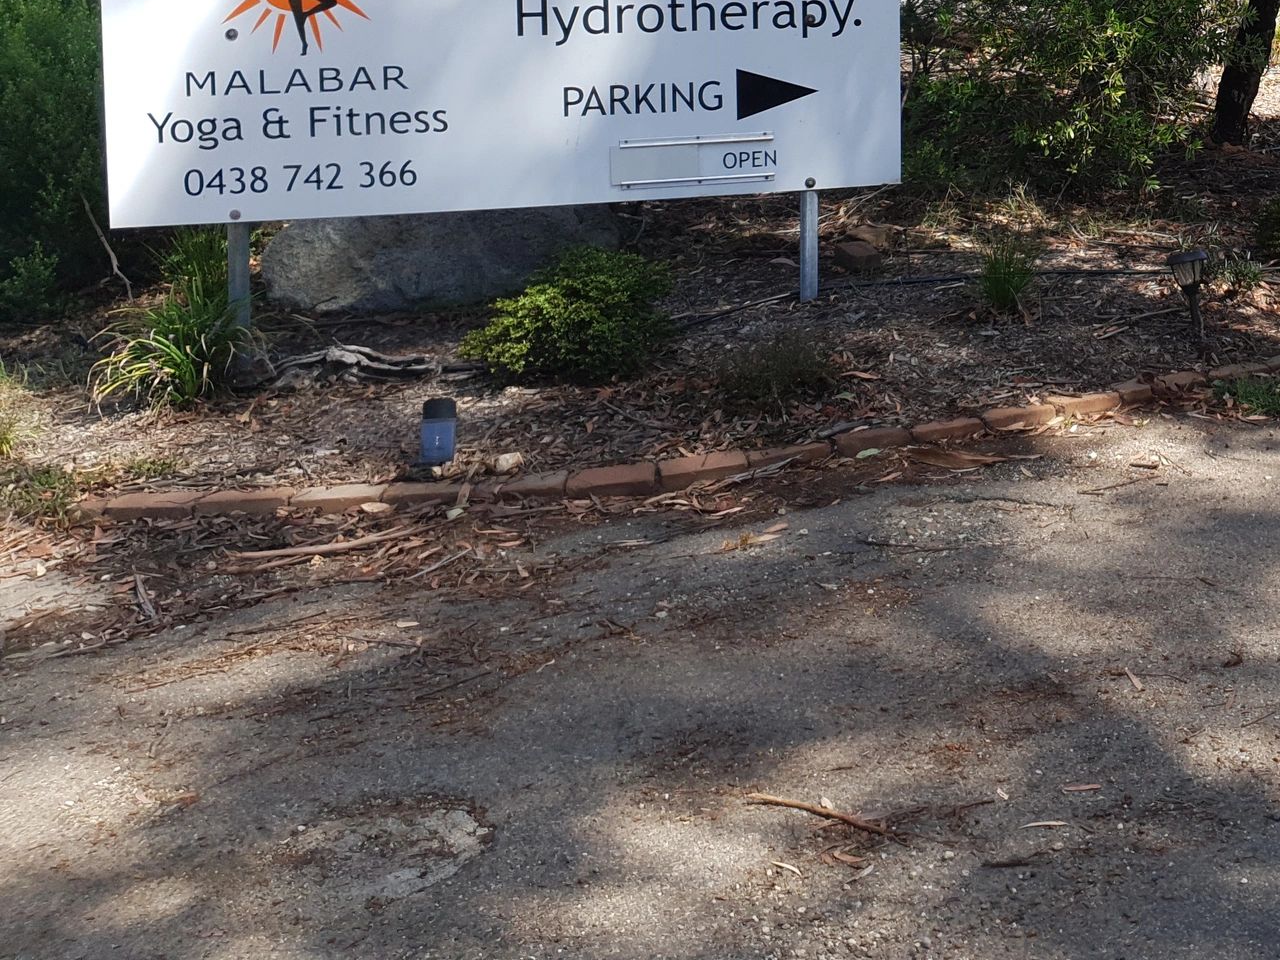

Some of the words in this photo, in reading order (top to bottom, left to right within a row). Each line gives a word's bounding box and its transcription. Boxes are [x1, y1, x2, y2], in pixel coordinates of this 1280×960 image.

[185, 65, 409, 98] MALABAR
[563, 80, 724, 118] PARKING
[146, 111, 244, 151] Yoga
[262, 107, 292, 140] &
[309, 105, 449, 138] Fitness
[183, 165, 269, 197] 0438
[282, 162, 344, 193] 742
[359, 159, 418, 189] 366
[722, 149, 777, 170] OPEN
